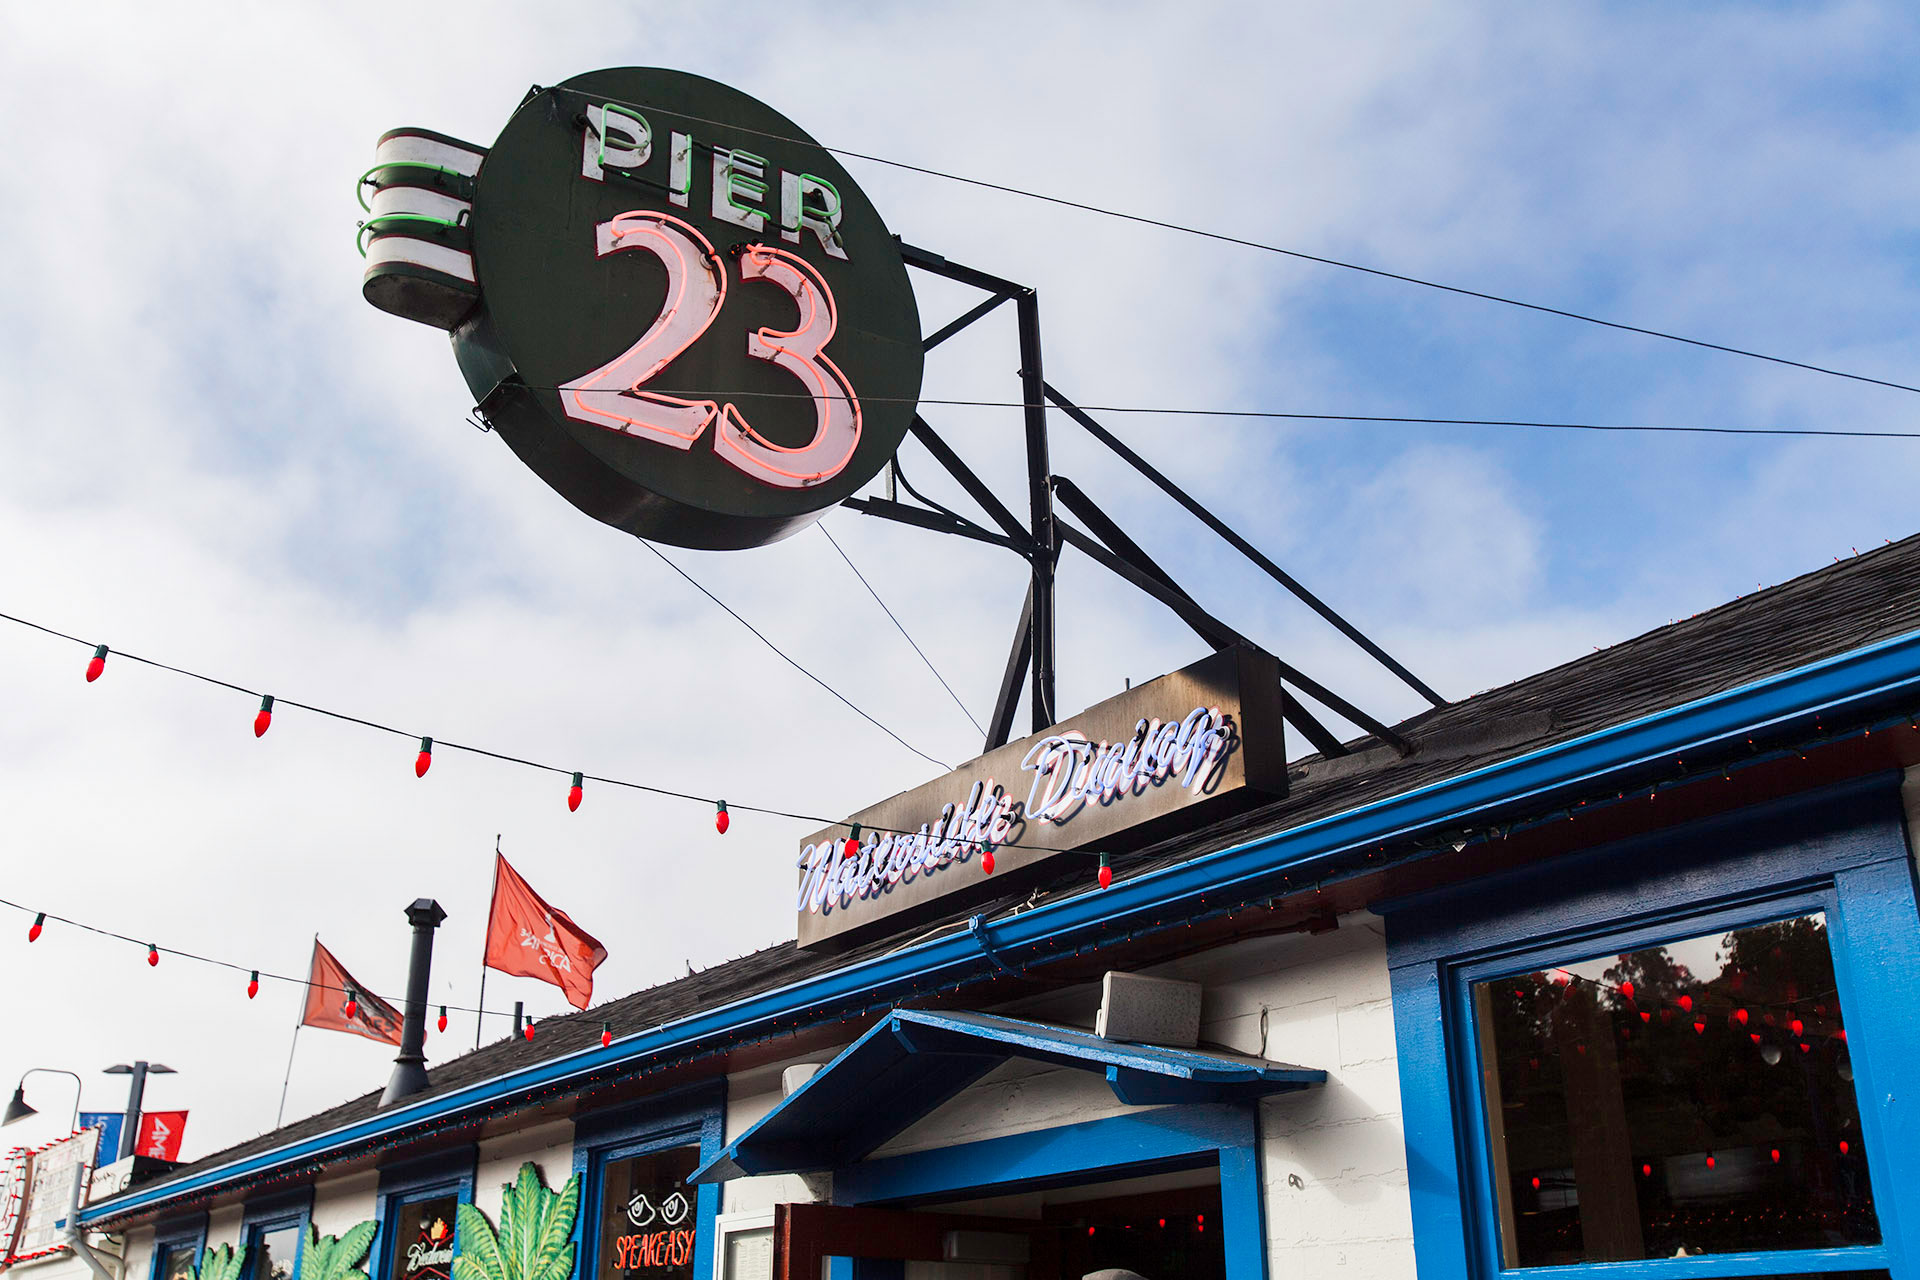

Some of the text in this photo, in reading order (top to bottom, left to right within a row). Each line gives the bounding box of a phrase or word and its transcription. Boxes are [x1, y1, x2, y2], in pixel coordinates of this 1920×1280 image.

[580, 102, 851, 261] PIER
[557, 209, 863, 489] 23
[797, 705, 1225, 915] Waterside Dining
[614, 1229, 696, 1270] SPEAKEASY
